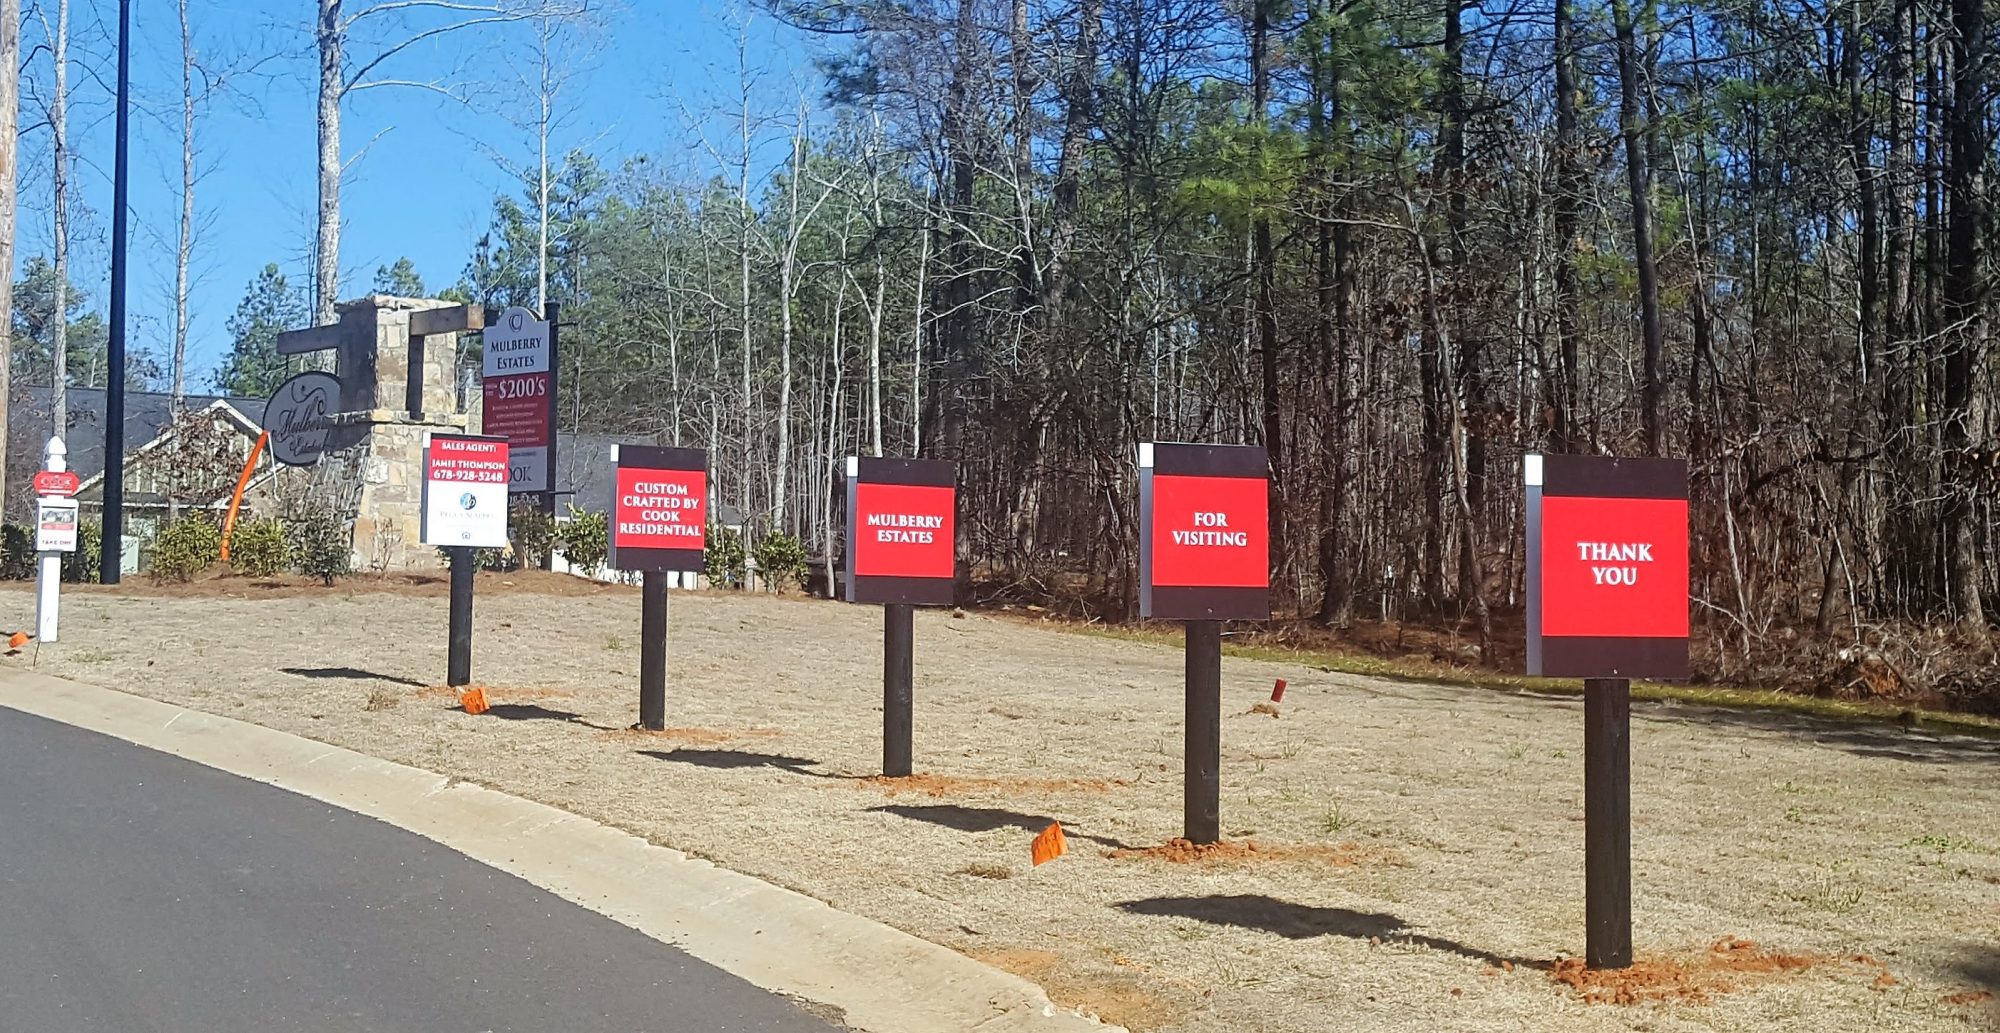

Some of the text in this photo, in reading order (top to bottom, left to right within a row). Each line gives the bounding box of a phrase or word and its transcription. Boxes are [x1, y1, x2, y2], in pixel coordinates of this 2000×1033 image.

[490, 337, 542, 353] MULBERRY
[497, 355, 535, 370] ESTATES
[441, 441, 497, 453] SALES AGENT:
[431, 459, 506, 470] JAMIE THOMPSON
[433, 469, 504, 482] 678-928-5248
[509, 465, 532, 482] OK
[634, 482, 688, 496] CUSTOM
[623, 495, 700, 510] CRAFTED BY
[641, 510, 681, 522] COOK
[867, 513, 944, 529] MULBERRY
[1194, 511, 1229, 528] FOR
[620, 522, 702, 537] RESIDENTIAL
[877, 529, 934, 544] ESTATES
[1172, 530, 1248, 547] VISITING
[1576, 541, 1654, 562] THANK
[1592, 566, 1638, 586] YOU
